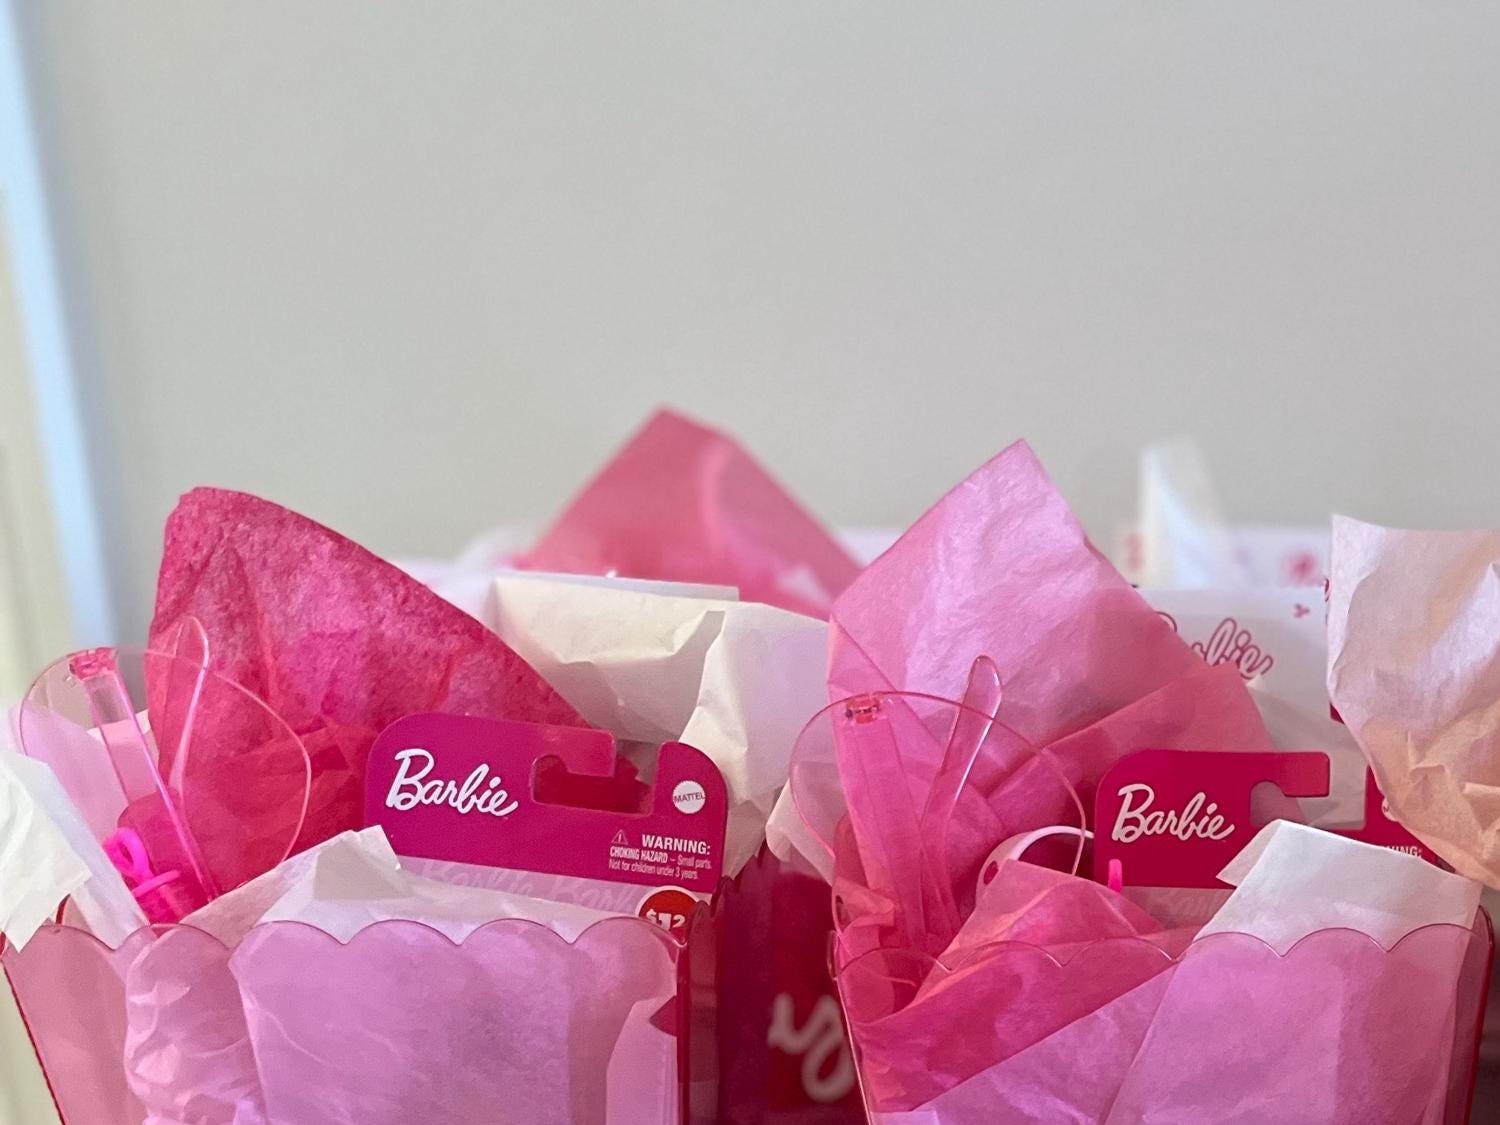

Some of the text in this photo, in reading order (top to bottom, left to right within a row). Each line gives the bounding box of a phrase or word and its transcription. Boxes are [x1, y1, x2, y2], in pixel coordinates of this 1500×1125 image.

[385, 748, 519, 817] Barbie
[673, 791, 706, 803] MATTEL
[1111, 783, 1235, 844] Barbie
[641, 834, 711, 855] WARNING:
[609, 859, 620, 870] Not
[621, 861, 630, 871] for
[610, 846, 640, 860] CHOKING
[641, 850, 668, 863] HAZARD
[677, 855, 695, 867] Small
